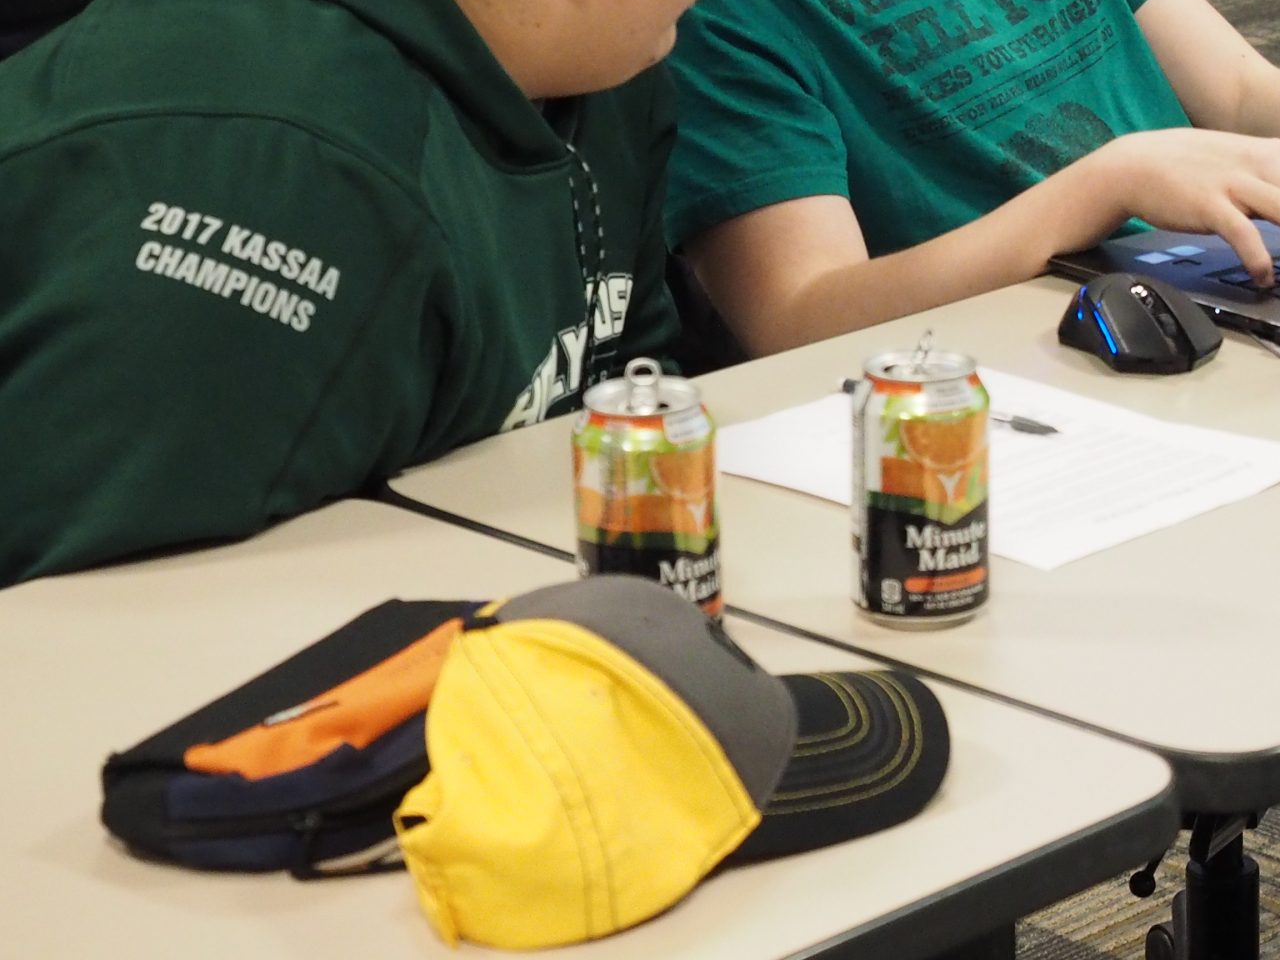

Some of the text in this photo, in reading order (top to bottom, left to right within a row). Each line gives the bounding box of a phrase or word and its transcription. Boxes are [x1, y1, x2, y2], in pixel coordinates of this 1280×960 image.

[135, 240, 316, 332] CHAMPIONS
[140, 201, 341, 300] 2017 KASSAA
[918, 540, 981, 571] Maid
